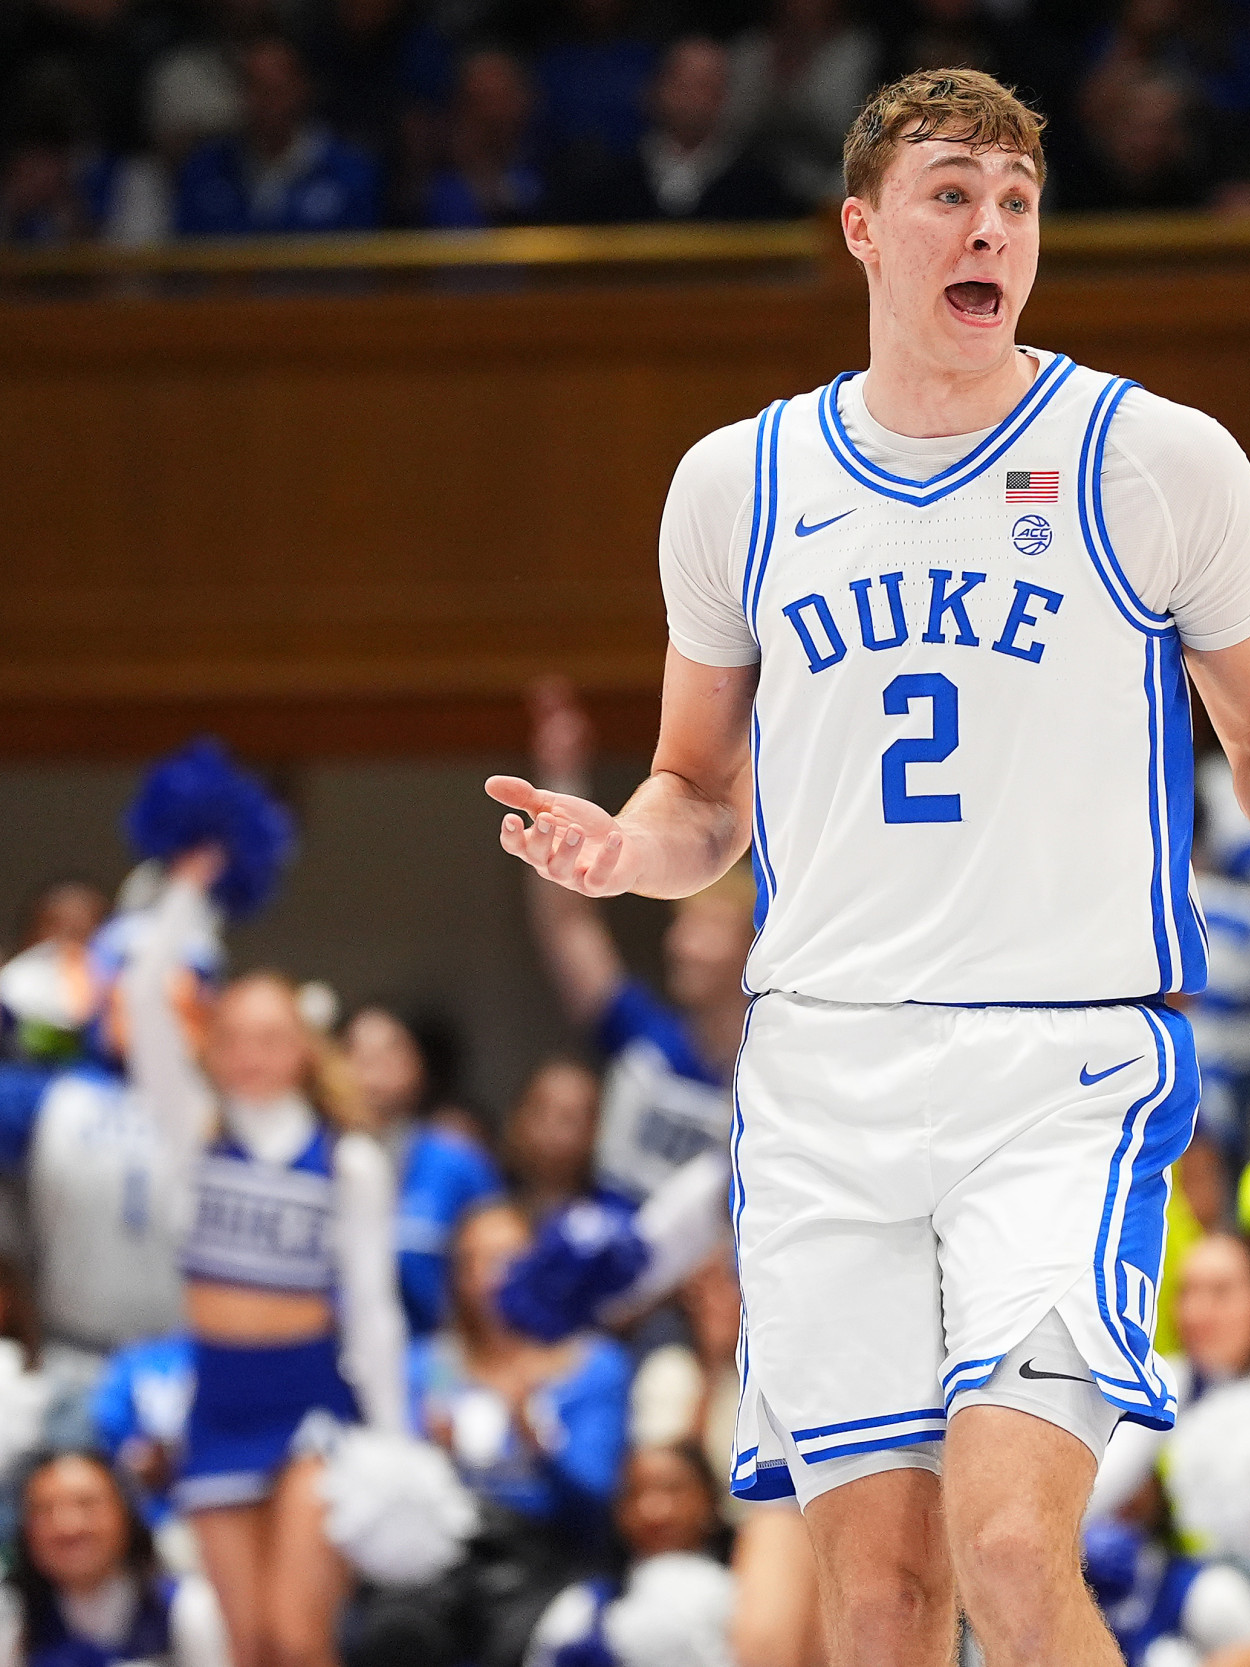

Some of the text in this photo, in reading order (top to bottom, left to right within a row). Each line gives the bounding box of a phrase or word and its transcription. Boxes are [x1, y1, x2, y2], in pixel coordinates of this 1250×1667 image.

[1017, 528, 1051, 537] ACC
[782, 568, 1064, 674] DUKE
[882, 672, 961, 824] 2
